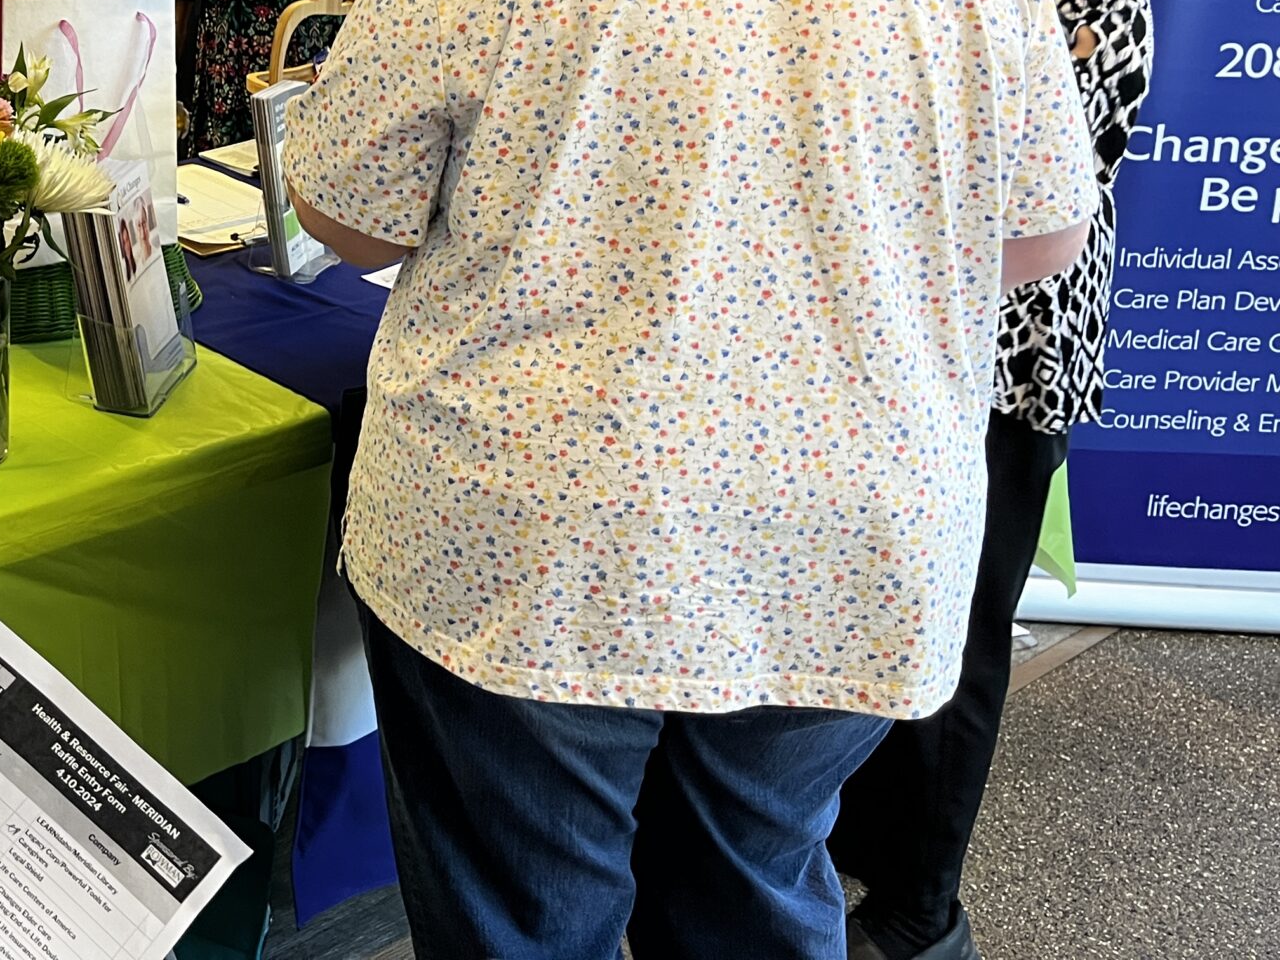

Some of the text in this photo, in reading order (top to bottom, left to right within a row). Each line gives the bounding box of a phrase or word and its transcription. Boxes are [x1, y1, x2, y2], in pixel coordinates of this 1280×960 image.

[1199, 177, 1259, 213] Be
[1119, 246, 1232, 270] Individual
[1114, 288, 1169, 310] Care
[1177, 288, 1226, 310] Plan
[1107, 328, 1200, 351] Medical
[1207, 331, 1261, 353] Care
[1103, 369, 1156, 390] Care
[1164, 371, 1260, 393] Provider
[1096, 408, 1227, 437] Counseling
[1233, 413, 1250, 432] &
[30, 702, 64, 734] Health
[59, 729, 73, 742] &
[67, 737, 113, 779] Resource
[108, 773, 130, 795] Fair
[130, 794, 181, 840] MERIDIAN
[50, 742, 128, 814] Raffle Entry Form
[53, 766, 103, 812] 4.10.2024
[7, 847, 26, 865] Legal
[23, 862, 44, 882] Shield
[85, 832, 123, 867] Company
[23, 829, 46, 851] Legacy
[84, 886, 104, 904] Tools
[100, 901, 113, 913] for
[94, 872, 119, 896] Library
[7, 872, 24, 888] Care
[20, 885, 47, 910] Centers
[44, 907, 53, 916] of
[50, 914, 78, 940] America
[20, 909, 39, 926] Elder
[35, 924, 53, 941] Care
[40, 944, 60, 960] Doul
